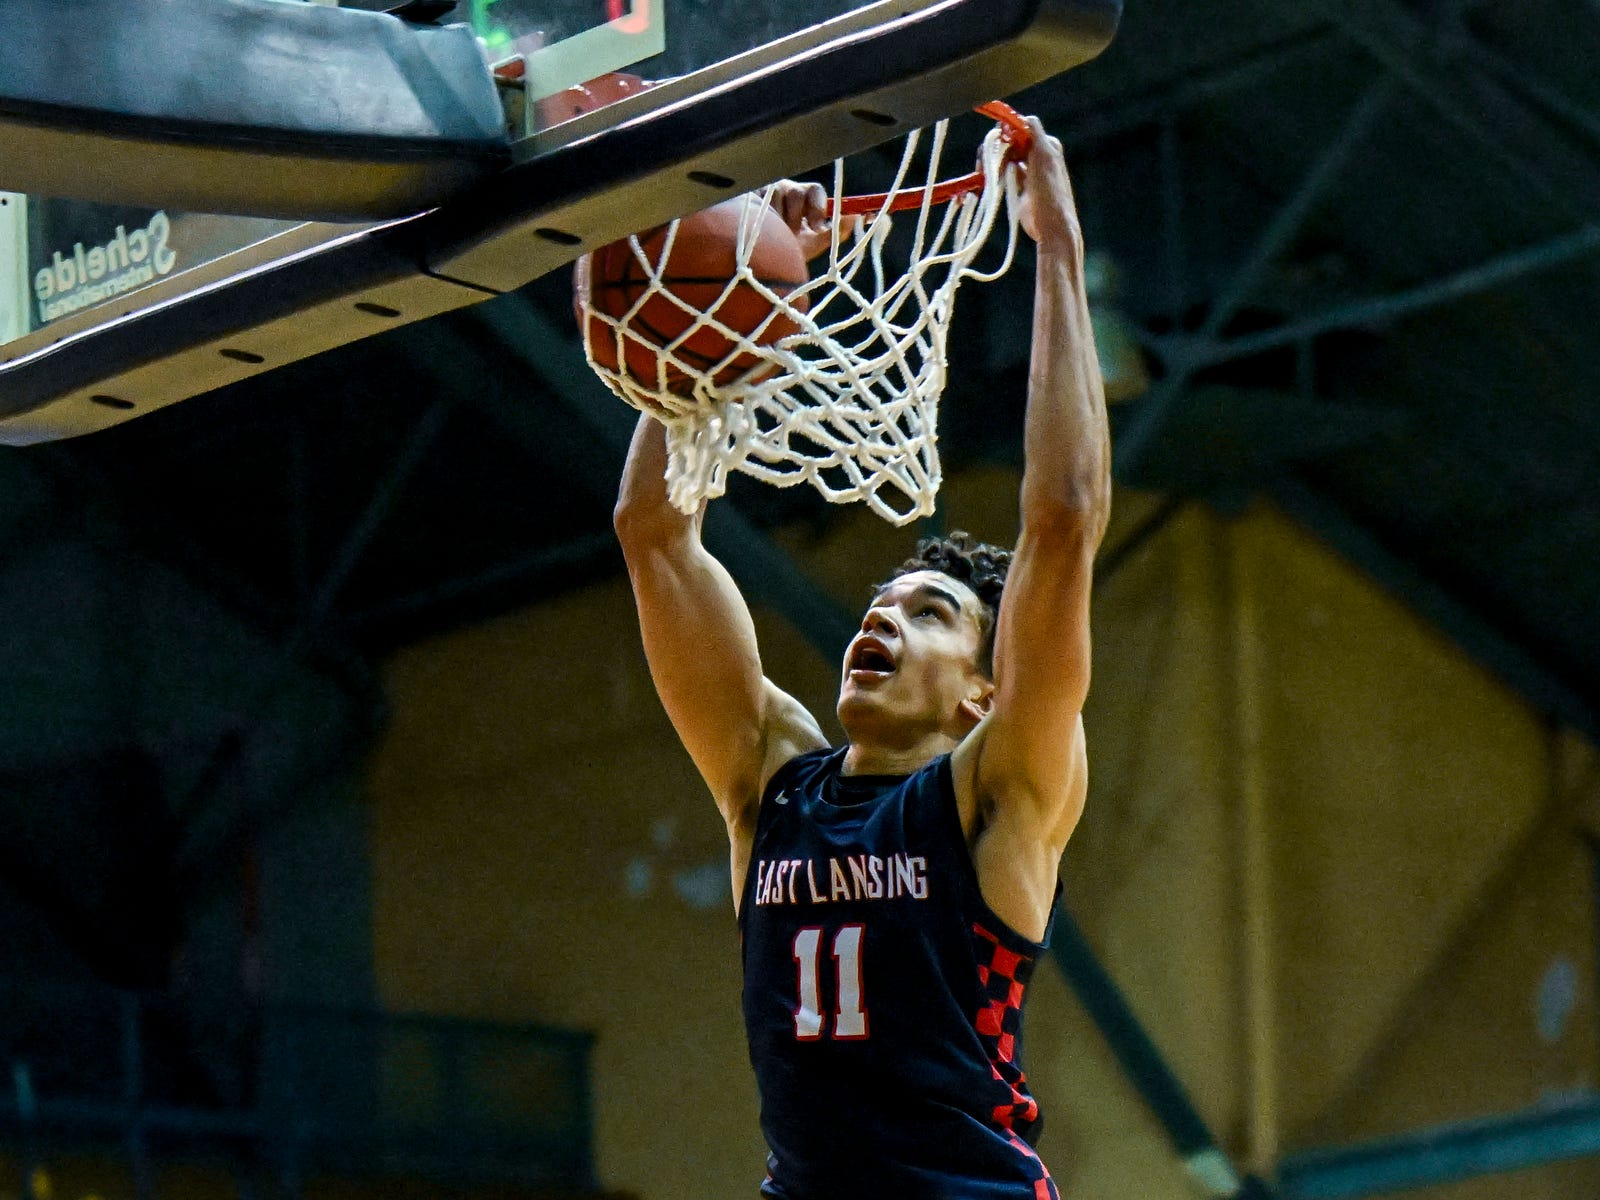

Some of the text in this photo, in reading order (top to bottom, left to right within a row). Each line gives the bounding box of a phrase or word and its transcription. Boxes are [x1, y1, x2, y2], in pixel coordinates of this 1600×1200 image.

[755, 852, 929, 905] EAST LANSING
[791, 922, 869, 1041] 11
